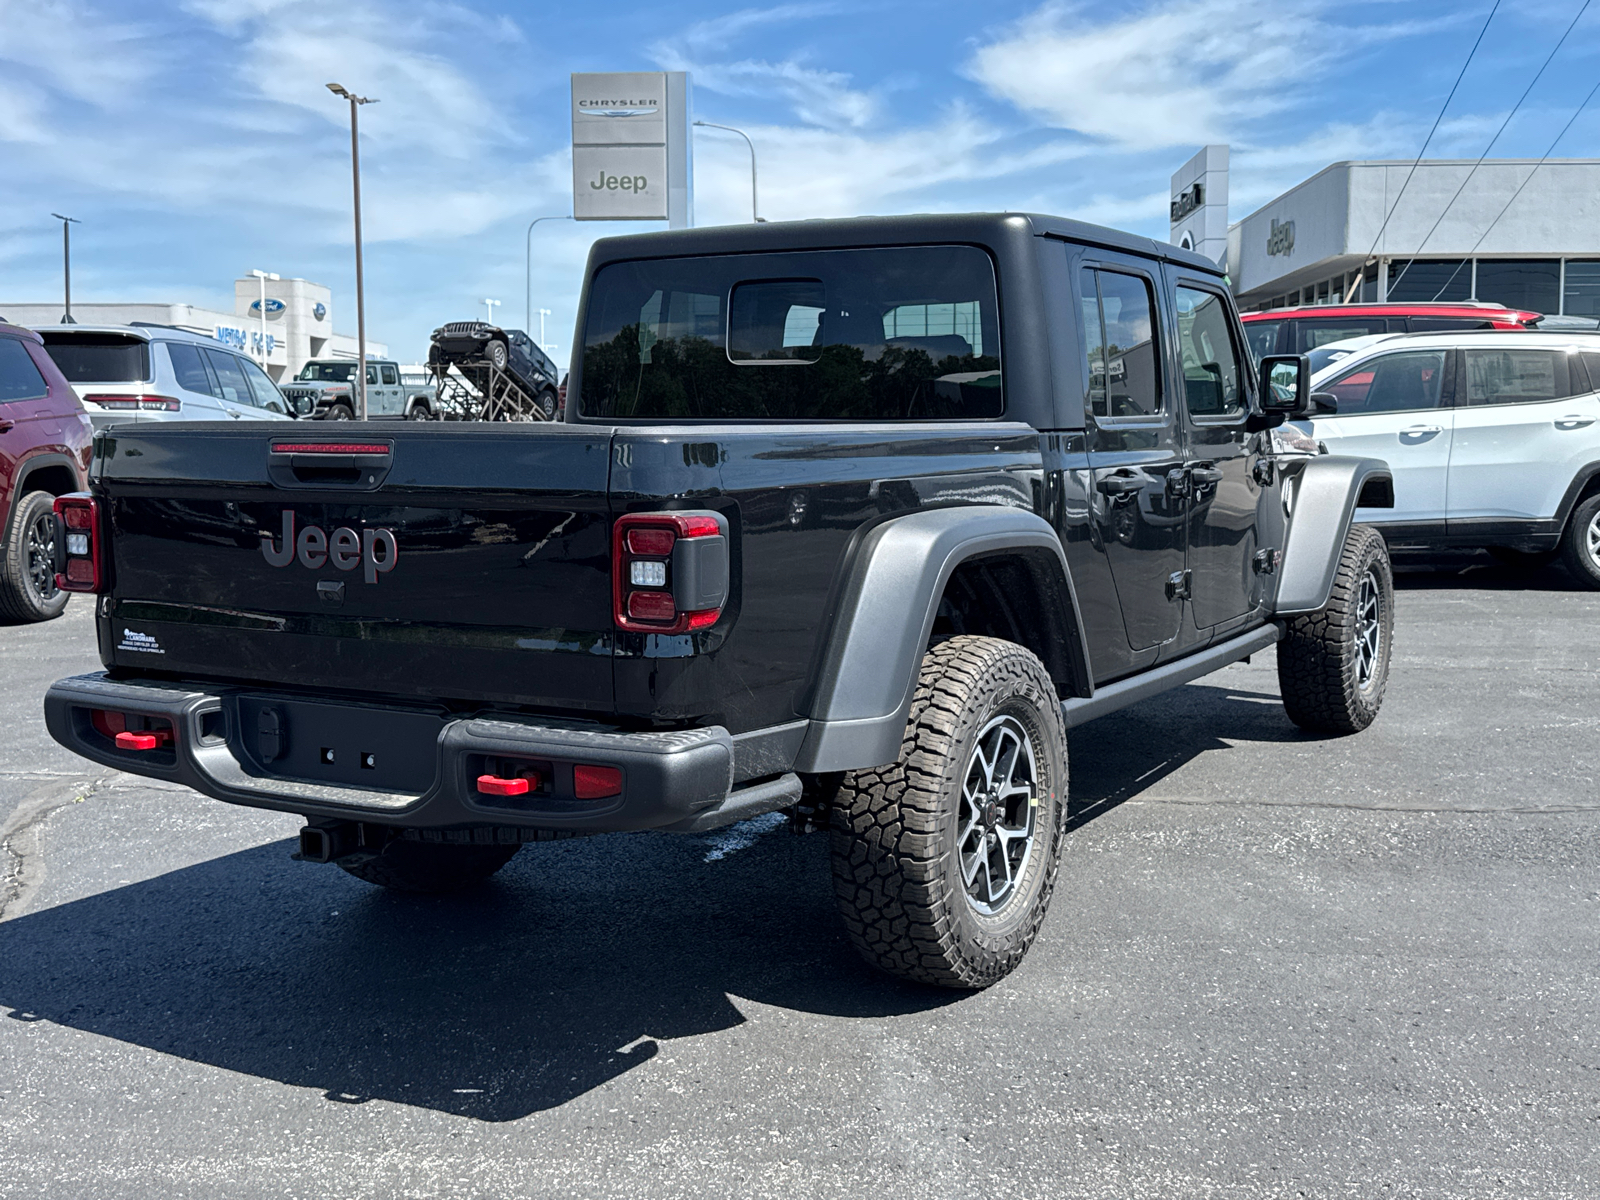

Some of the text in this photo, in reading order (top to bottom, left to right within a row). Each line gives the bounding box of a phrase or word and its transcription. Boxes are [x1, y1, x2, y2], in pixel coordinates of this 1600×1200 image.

[578, 99, 658, 107] CHRYSLER
[590, 170, 647, 194] Jeep
[1266, 218, 1296, 257] Jeep
[217, 327, 246, 345] METRO
[262, 509, 398, 584] Jeep
